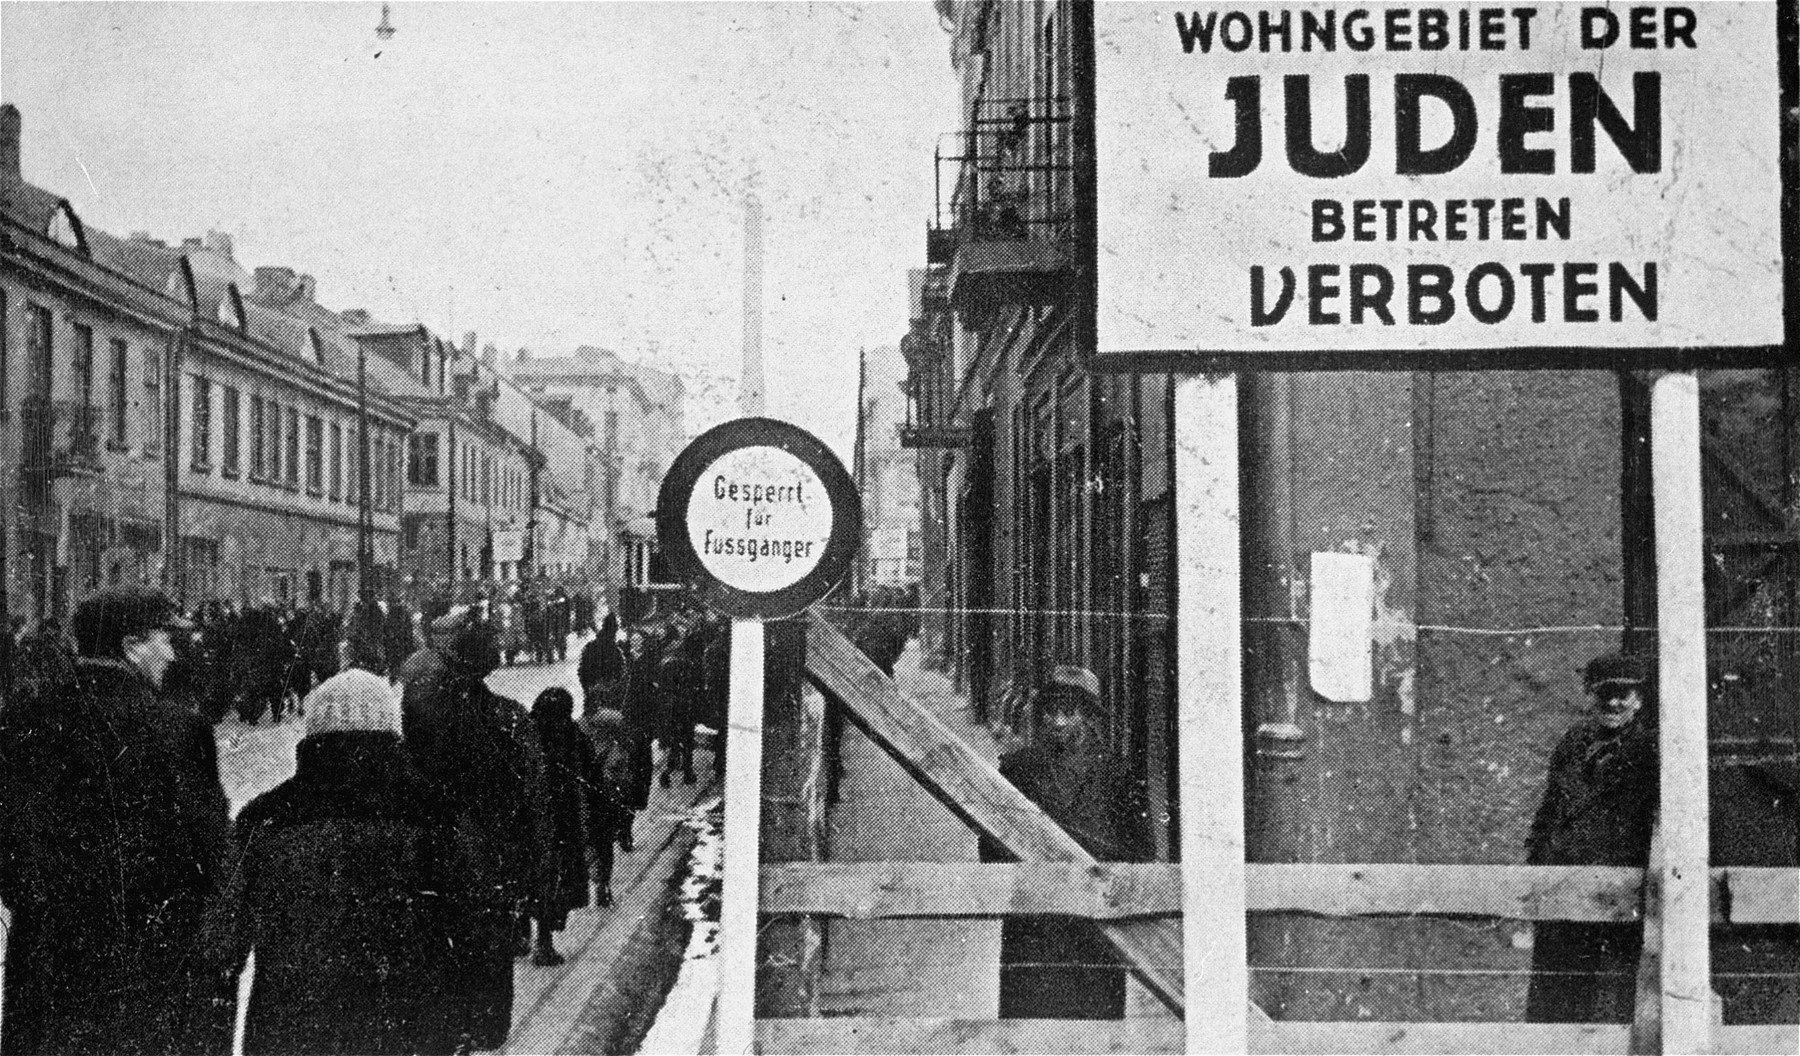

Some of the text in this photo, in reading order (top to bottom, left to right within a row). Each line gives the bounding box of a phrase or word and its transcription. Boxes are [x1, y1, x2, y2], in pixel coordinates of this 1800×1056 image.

[1176, 6, 1697, 54] WOHNGEBIET DER
[1209, 71, 1662, 178] JUDEN
[1312, 198, 1571, 242] BETRETEN
[1250, 262, 1658, 327] VERBOTEN
[714, 475, 803, 505] Gesperrt
